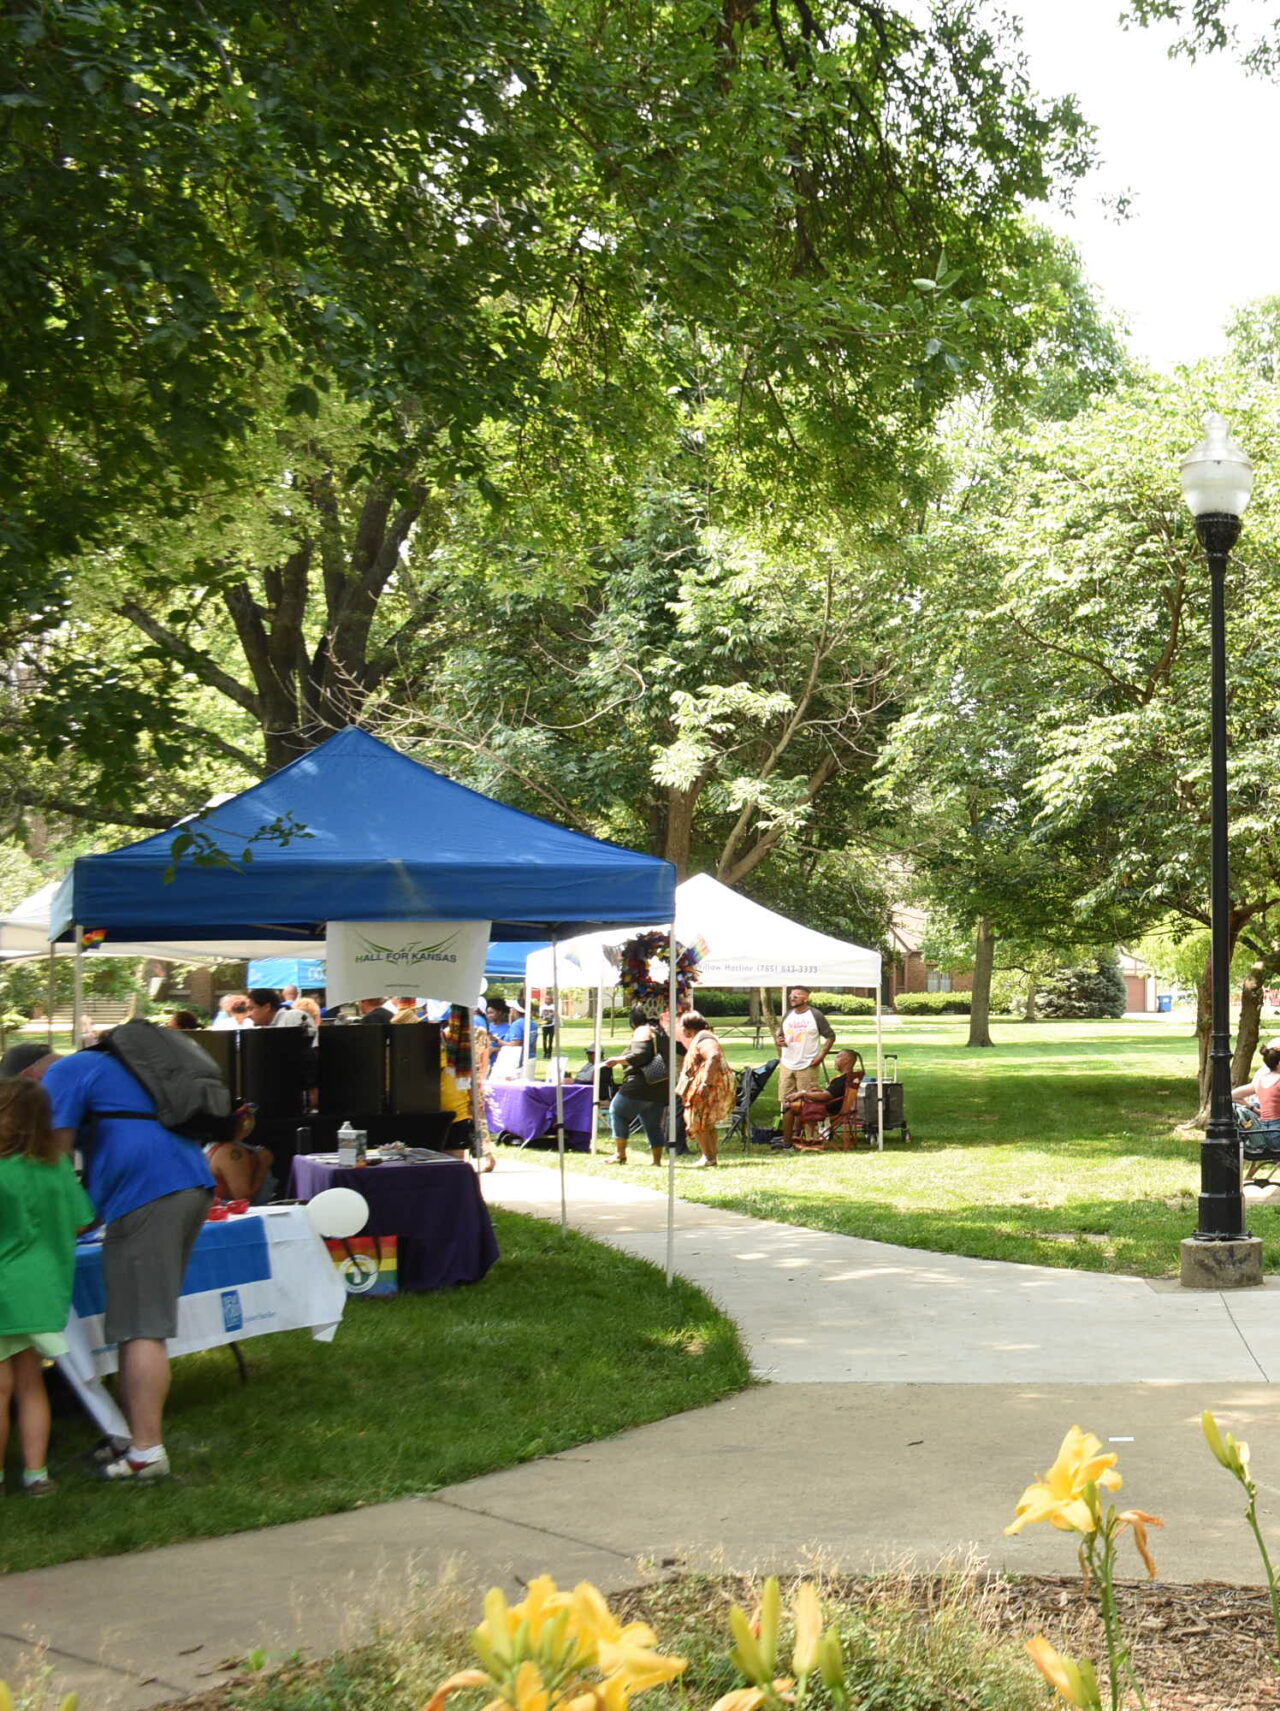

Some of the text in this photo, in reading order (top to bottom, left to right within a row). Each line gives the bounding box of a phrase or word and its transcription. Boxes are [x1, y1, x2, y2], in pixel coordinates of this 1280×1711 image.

[355, 951, 457, 964] HALL FOR KANSAS
